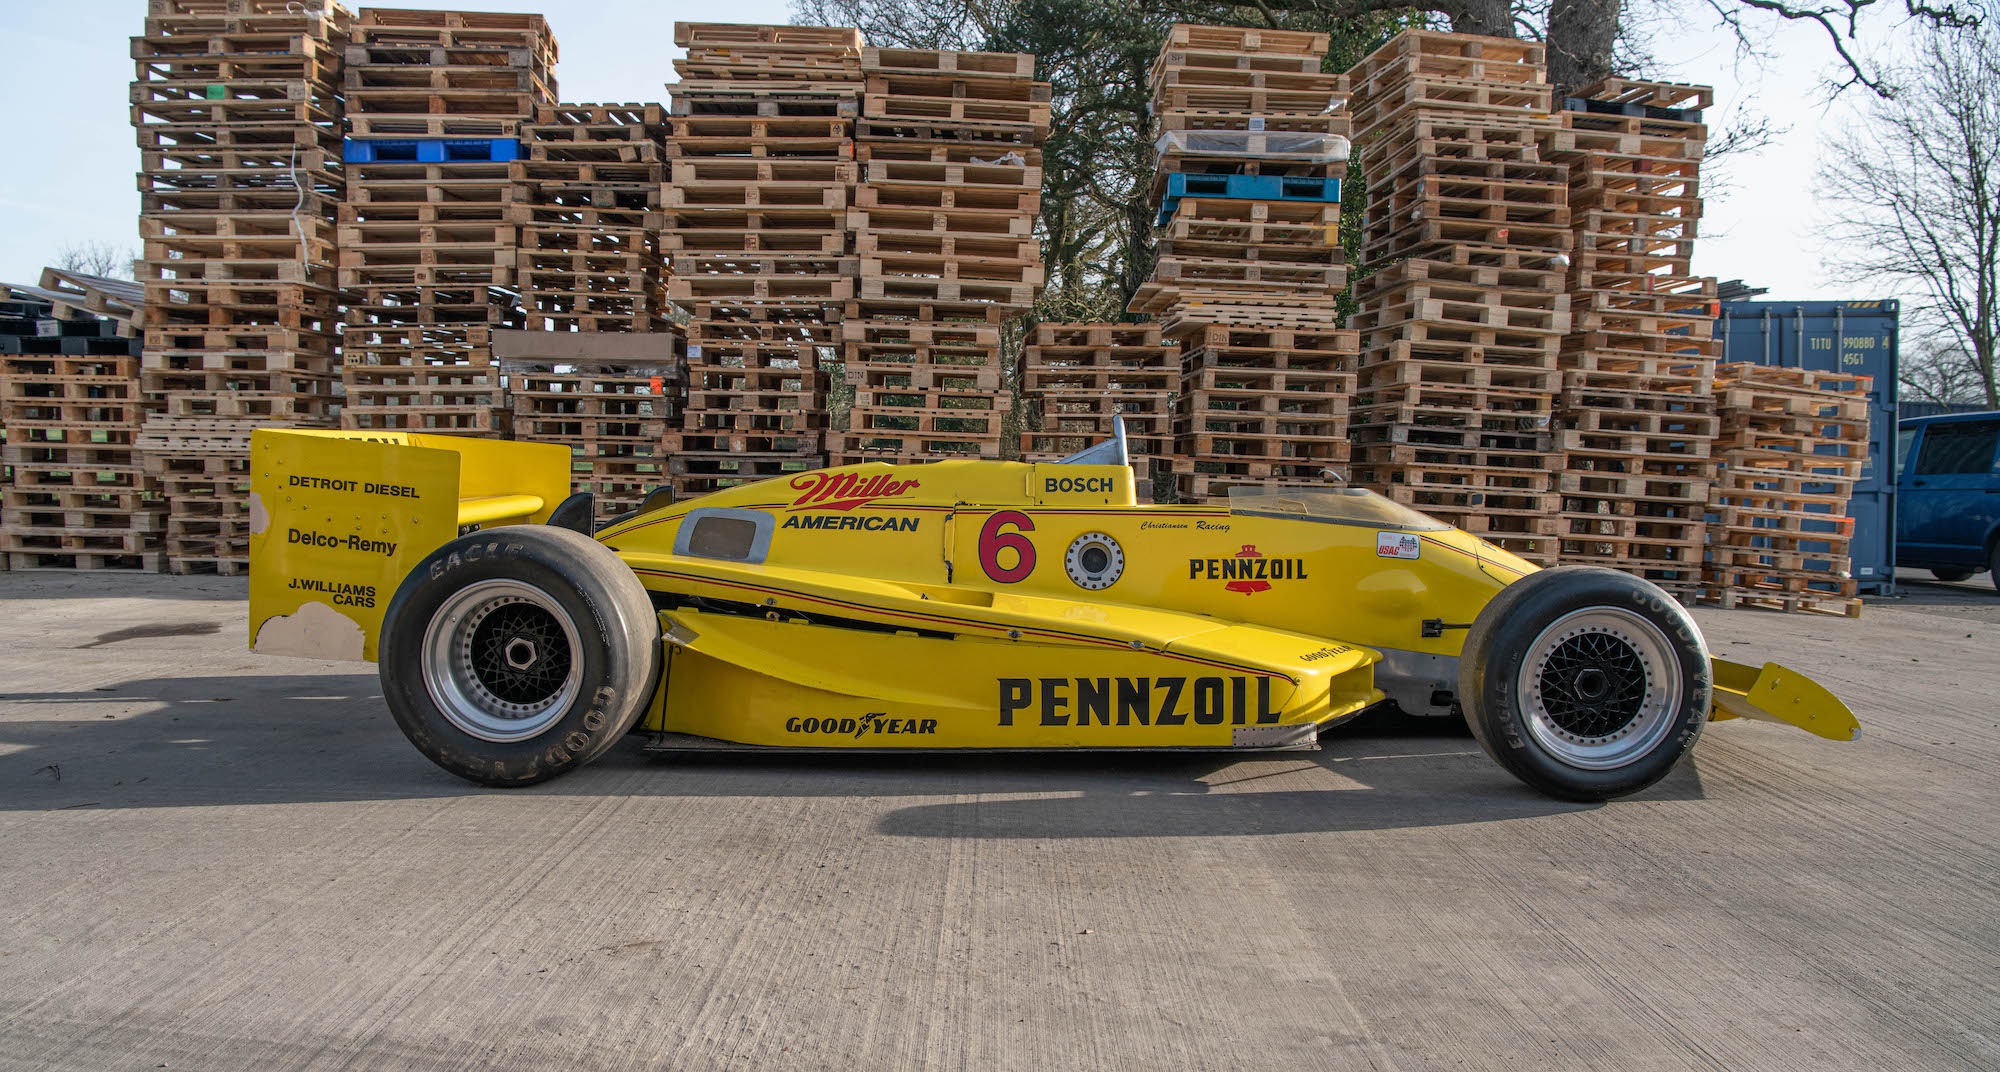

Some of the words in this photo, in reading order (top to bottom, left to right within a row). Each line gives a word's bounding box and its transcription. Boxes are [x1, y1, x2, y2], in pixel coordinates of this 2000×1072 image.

[1811, 337, 1832, 350] TITU
[1843, 336, 1875, 349] 990880
[1843, 352, 1864, 365] 45G1
[847, 371, 864, 379] DIN
[289, 475, 358, 492] DETROIT
[364, 482, 420, 499] DIESEL
[785, 472, 921, 511] Miller
[1045, 477, 1114, 493] BOSCH
[781, 515, 921, 532] AMERICAN
[1140, 521, 1188, 531] Christiansen
[1196, 520, 1231, 533] Racing
[288, 528, 398, 557] Delco-Remy
[978, 510, 1037, 584] 6
[1378, 545, 1400, 556] USAC
[1189, 558, 1309, 580] PENNZOIL
[288, 578, 376, 597] J.WILLIAMS
[332, 594, 376, 608] CARS
[997, 677, 1282, 727] PENNZOIL
